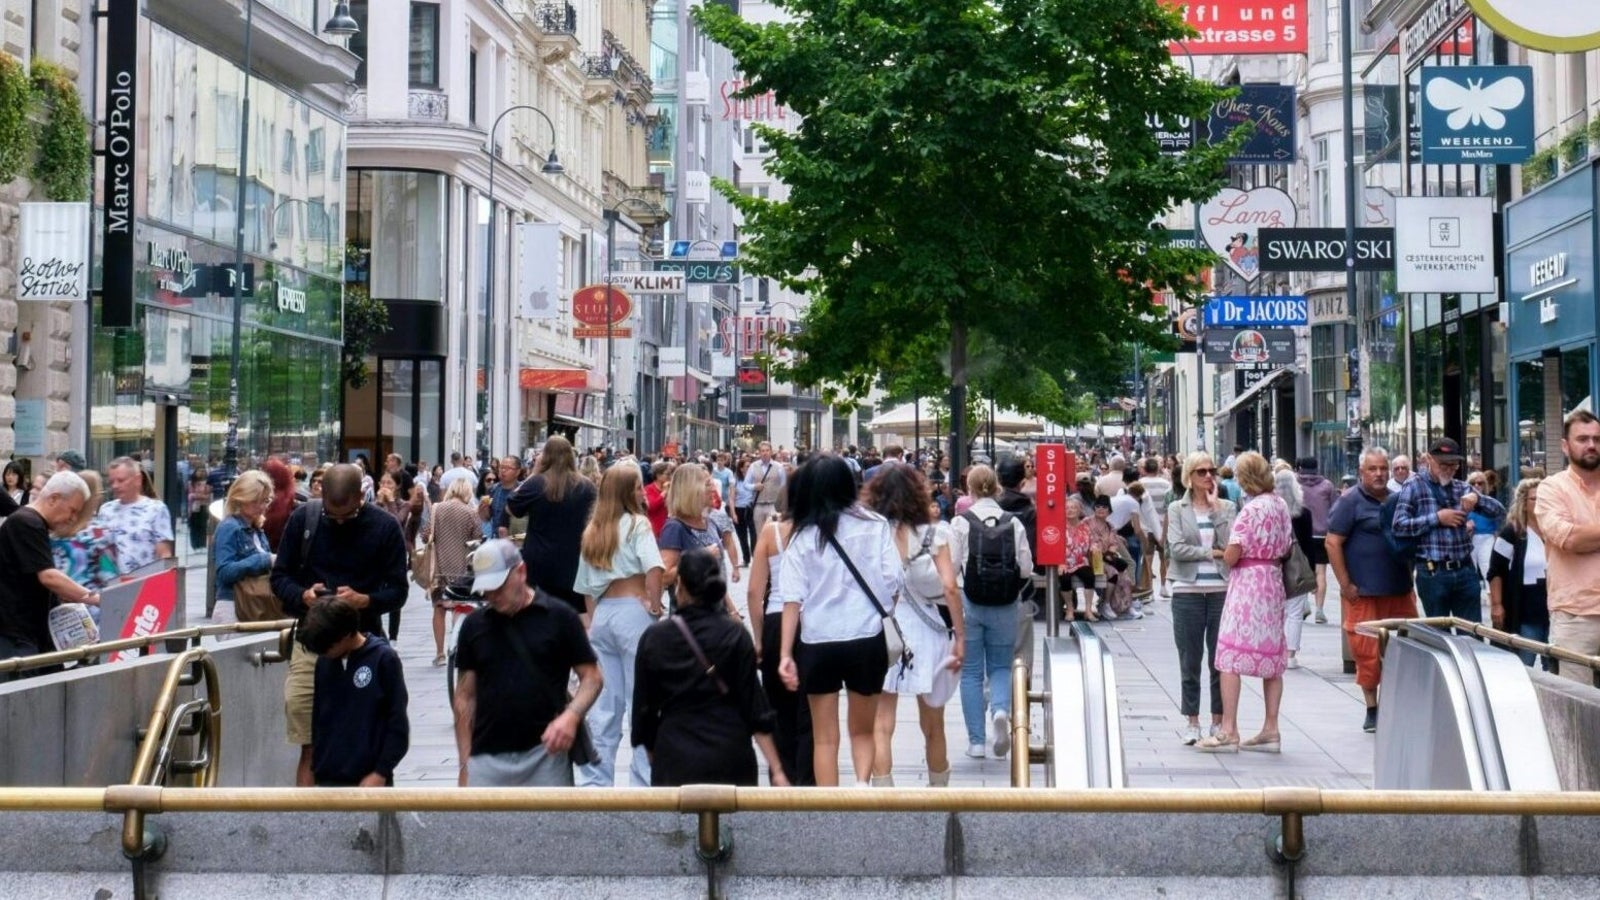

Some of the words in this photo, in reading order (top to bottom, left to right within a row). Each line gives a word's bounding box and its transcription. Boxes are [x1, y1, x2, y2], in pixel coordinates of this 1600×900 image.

[1182, 5, 1219, 22] ffl
[1240, 4, 1295, 21] und
[1184, 27, 1276, 43] strasse
[1282, 25, 1297, 42] 5
[110, 71, 131, 157] O'Polo
[1216, 97, 1253, 119] Chez
[1254, 104, 1291, 137] Nous
[1441, 137, 1513, 146] WEEKEND
[108, 163, 129, 233] Marc
[1208, 192, 1286, 228] Lanz
[1268, 240, 1393, 259] SWAROSKI
[20, 257, 36, 276] &
[37, 257, 84, 279] other
[21, 276, 79, 297] Stories
[634, 276, 684, 290] KLIMT
[1224, 301, 1244, 321] Dr
[1246, 300, 1307, 321] JACOBS
[1046, 449, 1056, 495] STOP
